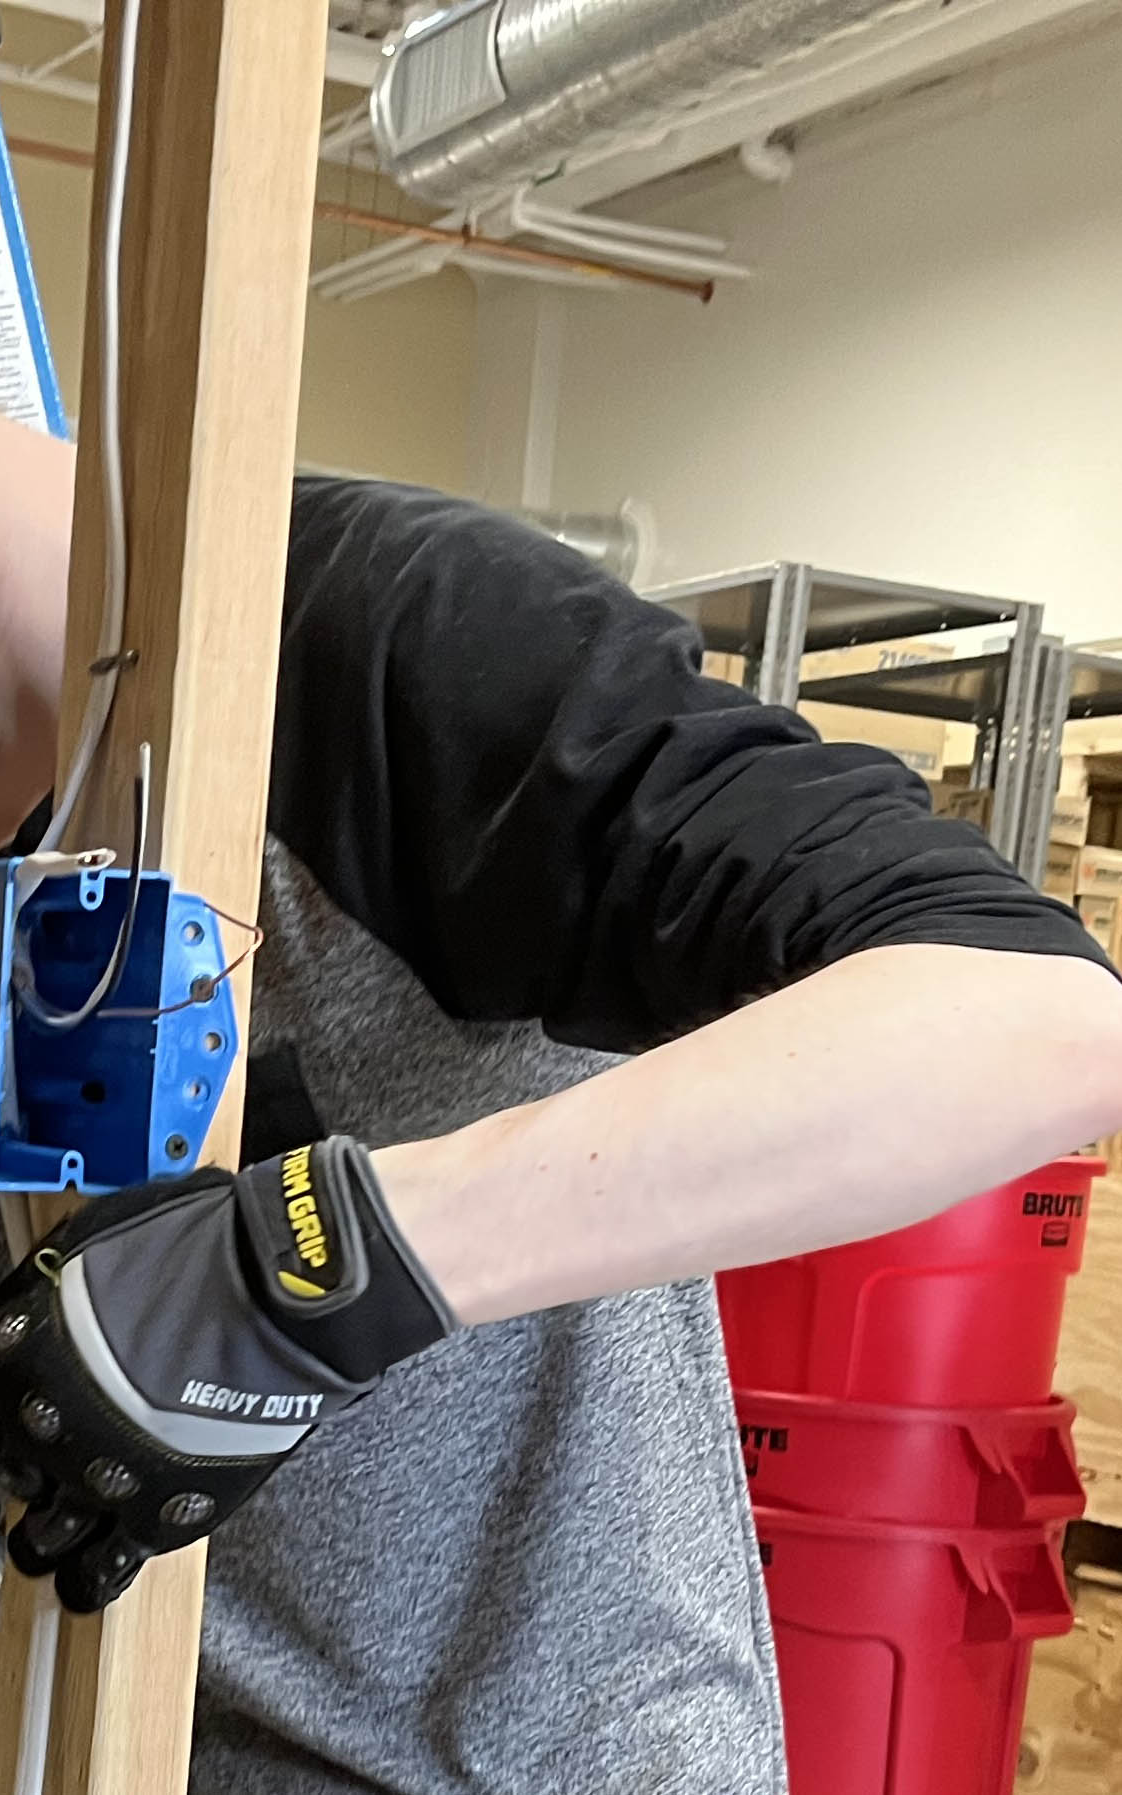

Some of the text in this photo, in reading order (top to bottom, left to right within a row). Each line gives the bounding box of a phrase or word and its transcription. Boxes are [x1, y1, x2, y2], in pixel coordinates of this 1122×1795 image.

[287, 1194, 327, 1268] GRIP
[180, 1379, 324, 1419] HEAVY DUTY
